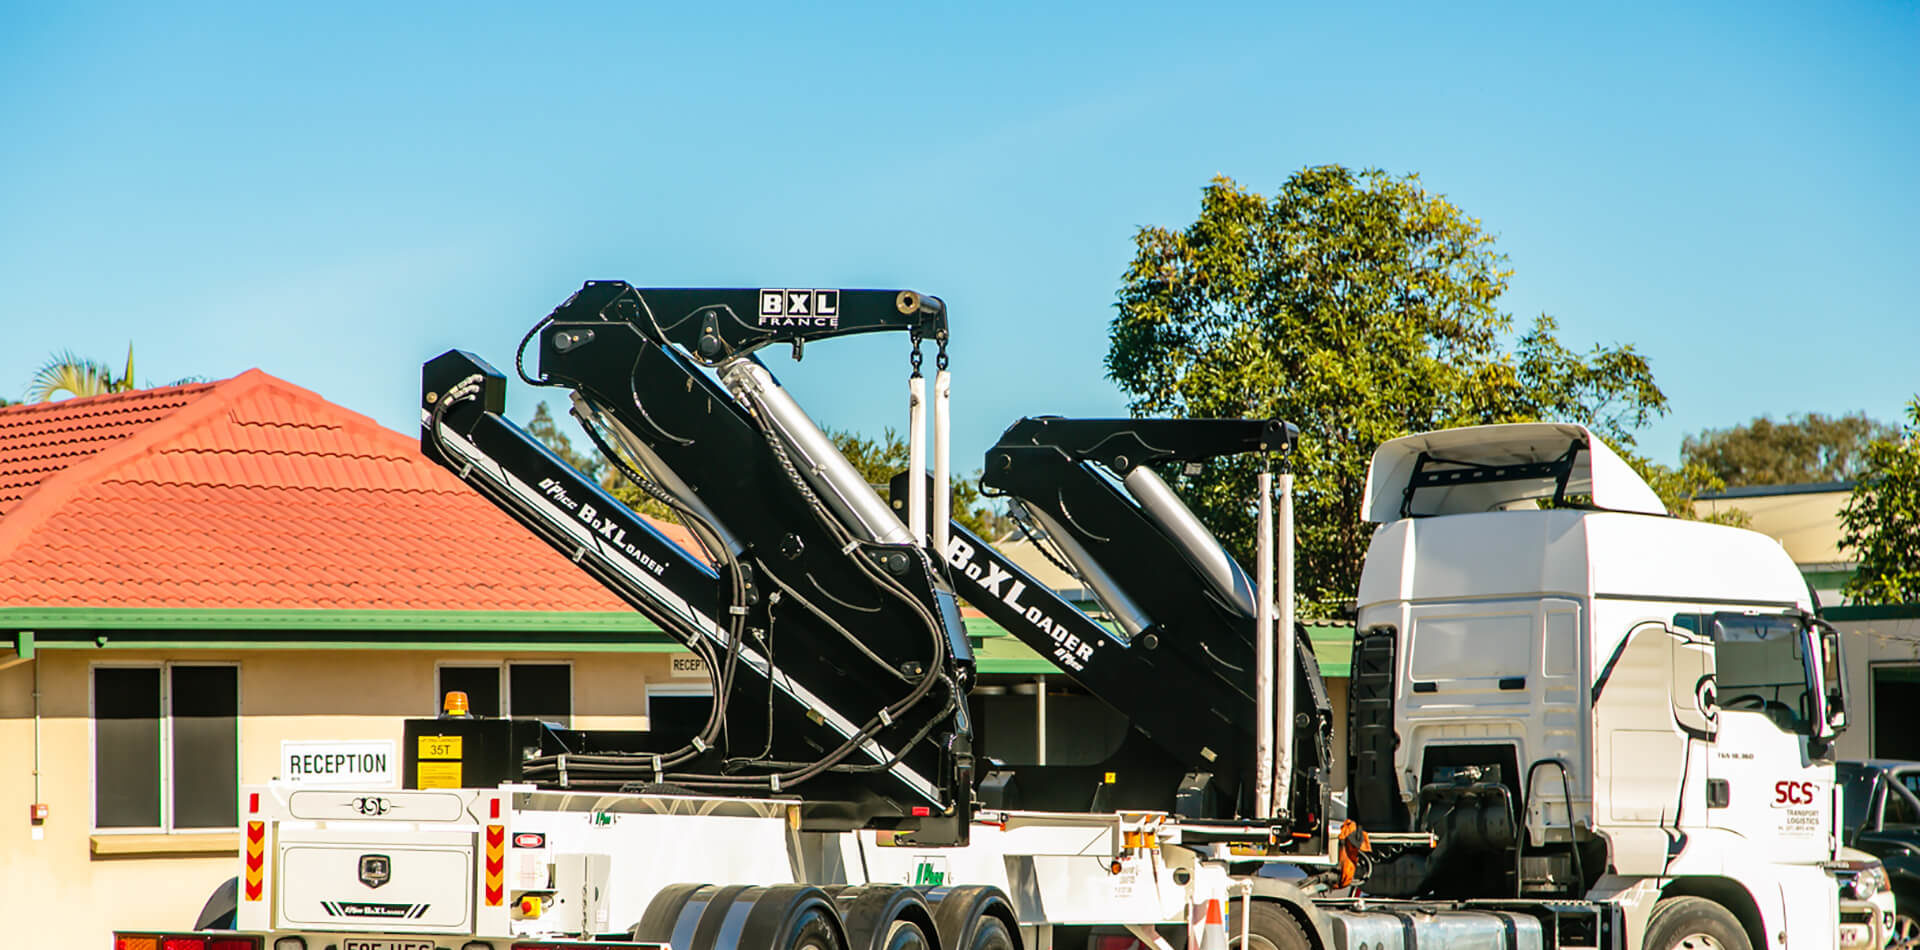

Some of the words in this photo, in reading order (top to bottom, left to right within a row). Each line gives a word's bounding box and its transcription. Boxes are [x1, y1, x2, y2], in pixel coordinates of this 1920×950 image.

[762, 292, 837, 314] BXL
[759, 318, 838, 327] FRANCE
[430, 744, 451, 755] 35T
[290, 753, 386, 774] RECEPTION
[1775, 780, 1813, 804] SCS
[1786, 817, 1819, 826] LOGISTICS
